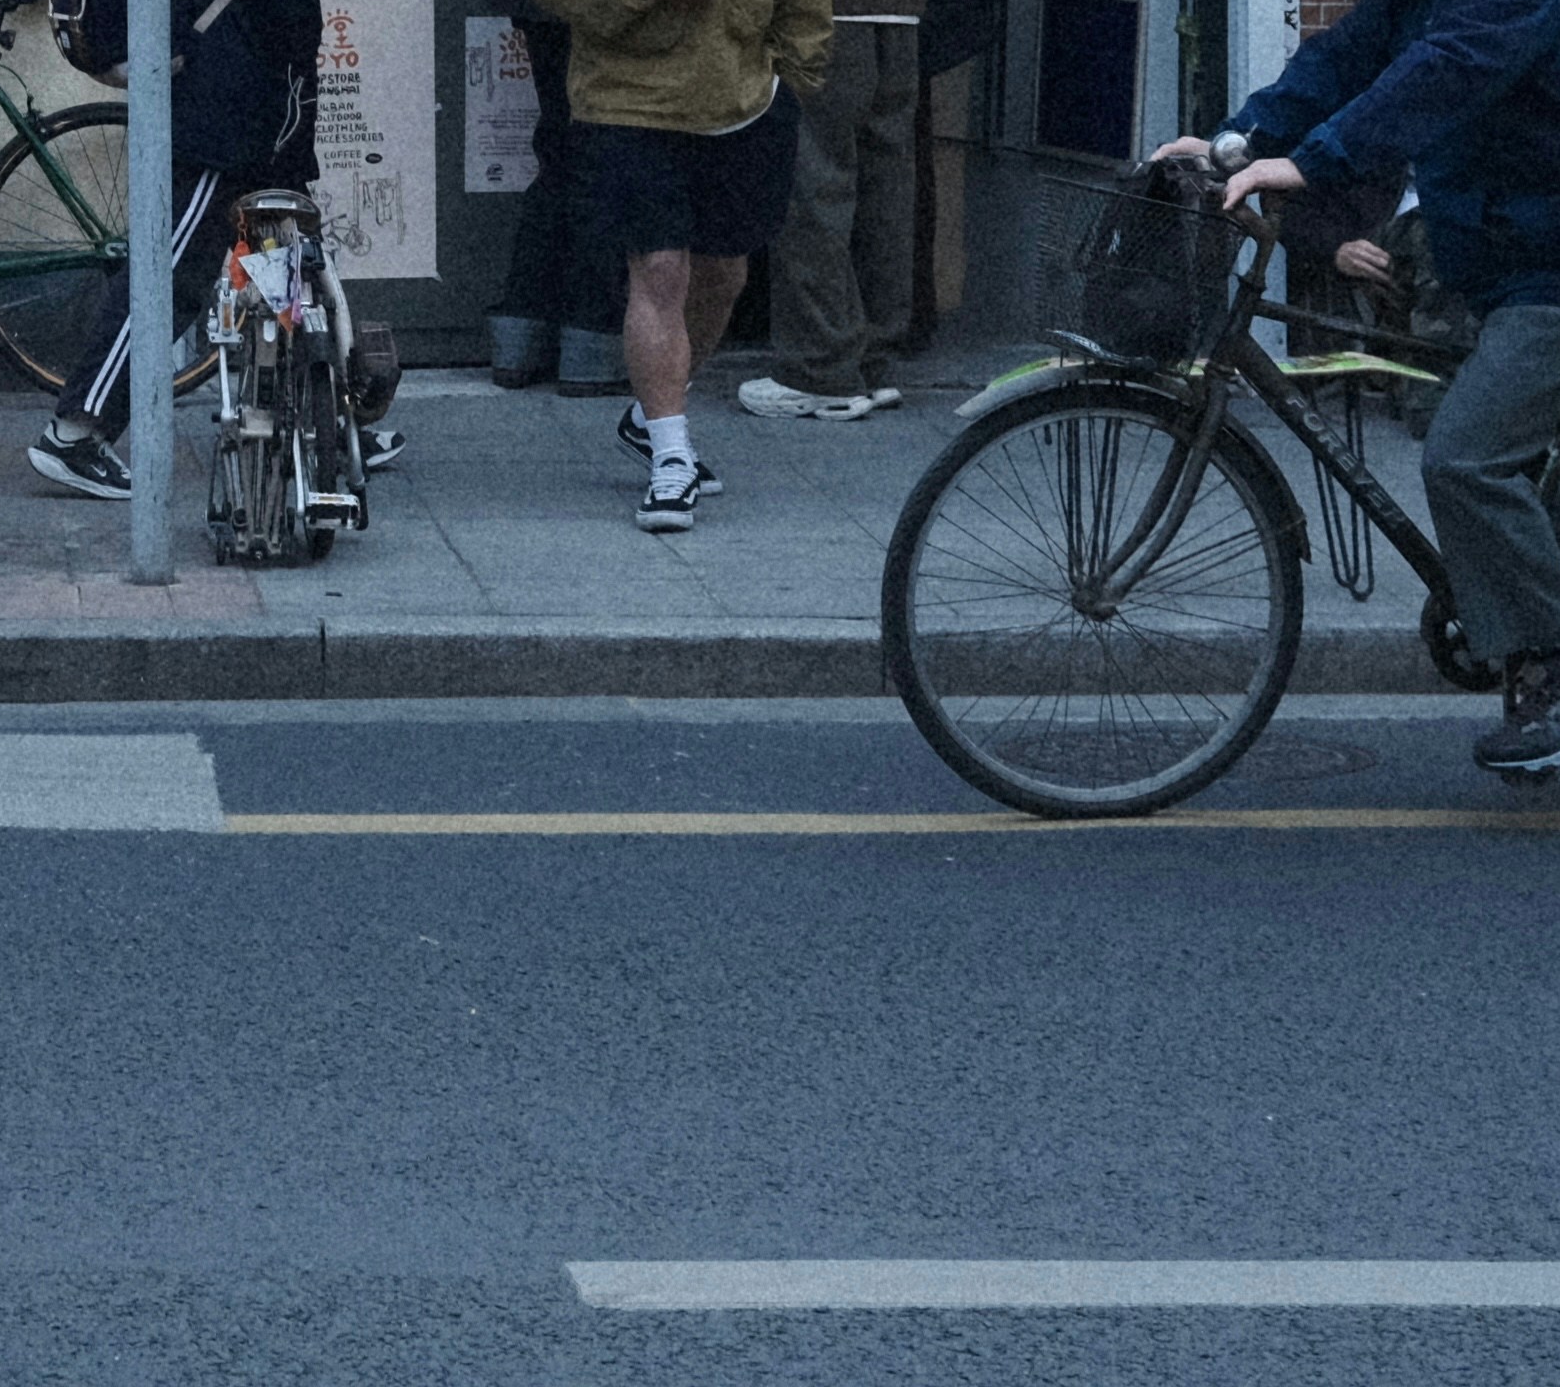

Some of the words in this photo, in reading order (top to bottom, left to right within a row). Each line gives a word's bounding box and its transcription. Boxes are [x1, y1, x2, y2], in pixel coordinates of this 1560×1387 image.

[315, 122, 368, 133] CLOTHING
[316, 132, 384, 144] ACCESSORIES
[323, 149, 362, 160] COFFEE
